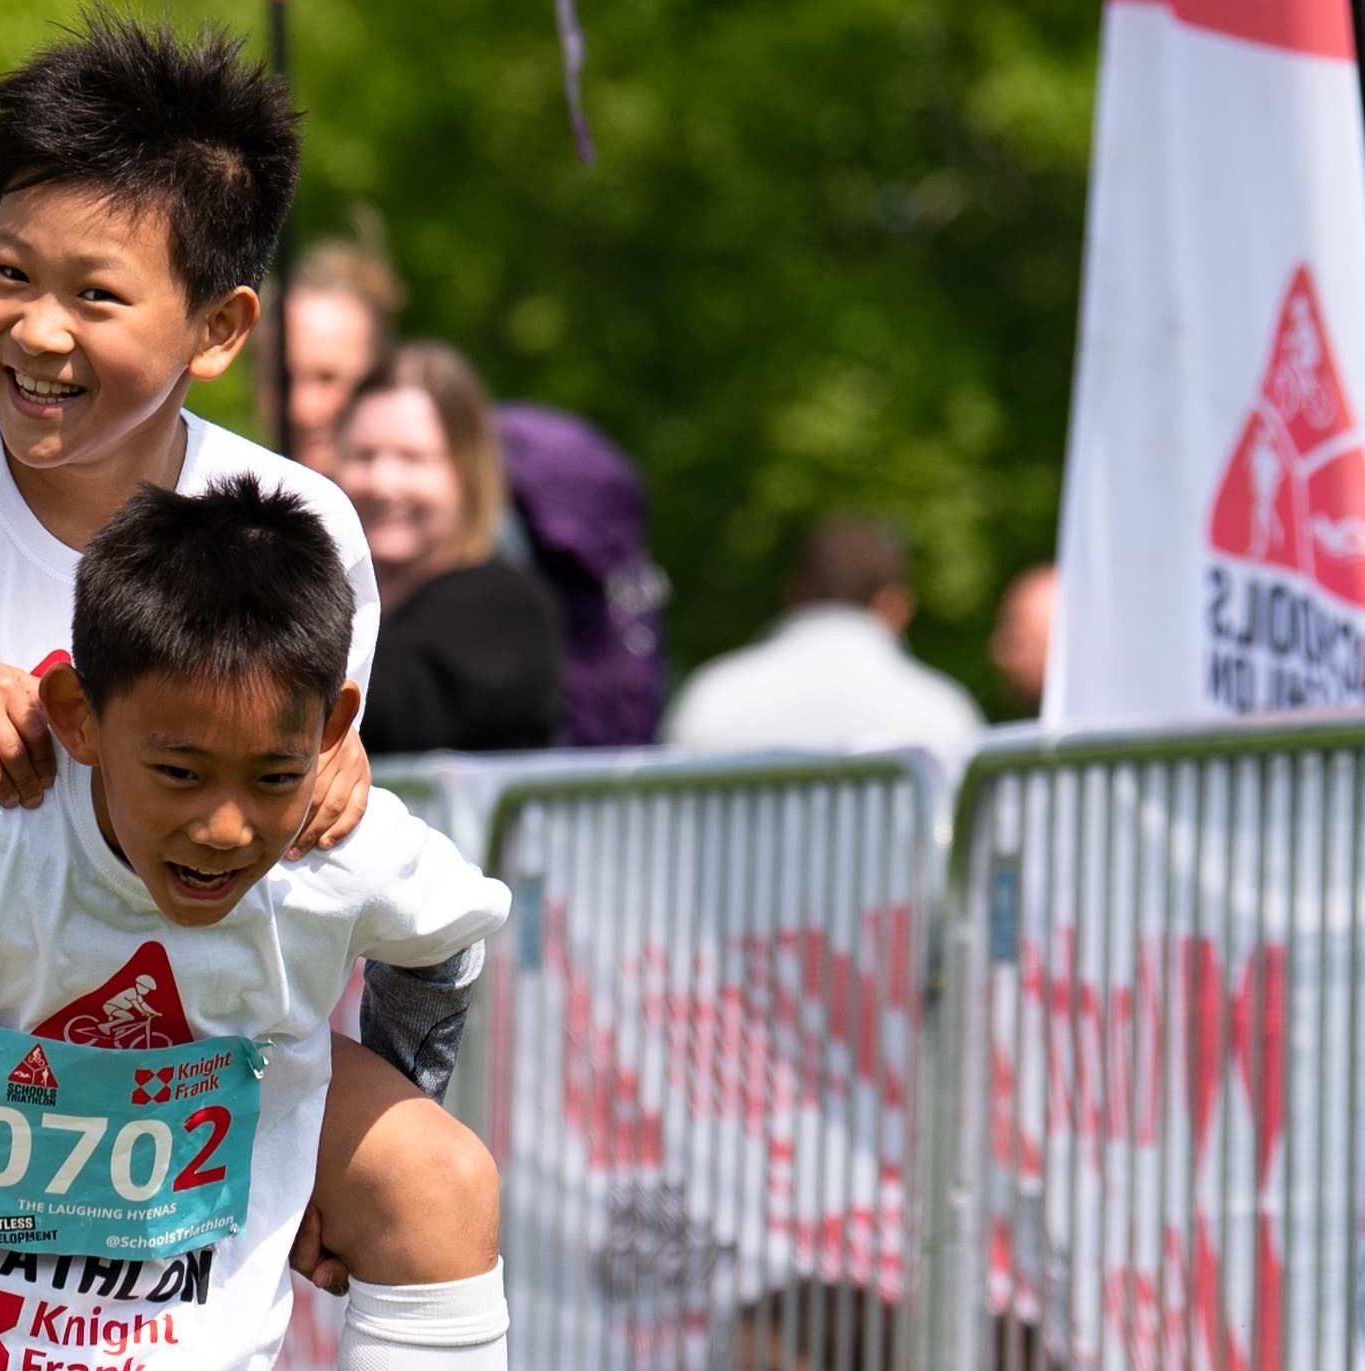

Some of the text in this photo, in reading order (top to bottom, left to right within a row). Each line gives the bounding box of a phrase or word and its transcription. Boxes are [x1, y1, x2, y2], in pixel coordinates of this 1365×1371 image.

[178, 1052, 231, 1081] Knight
[6, 1082, 57, 1100] SCHOOLS
[6, 1092, 57, 1107] TRIATHLON
[174, 1073, 220, 1101] Frank
[18, 1198, 177, 1221] THE LAUGHING HYENAS
[105, 1215, 234, 1249] @SchoolsTriathlon
[29, 1300, 180, 1356] Knight
